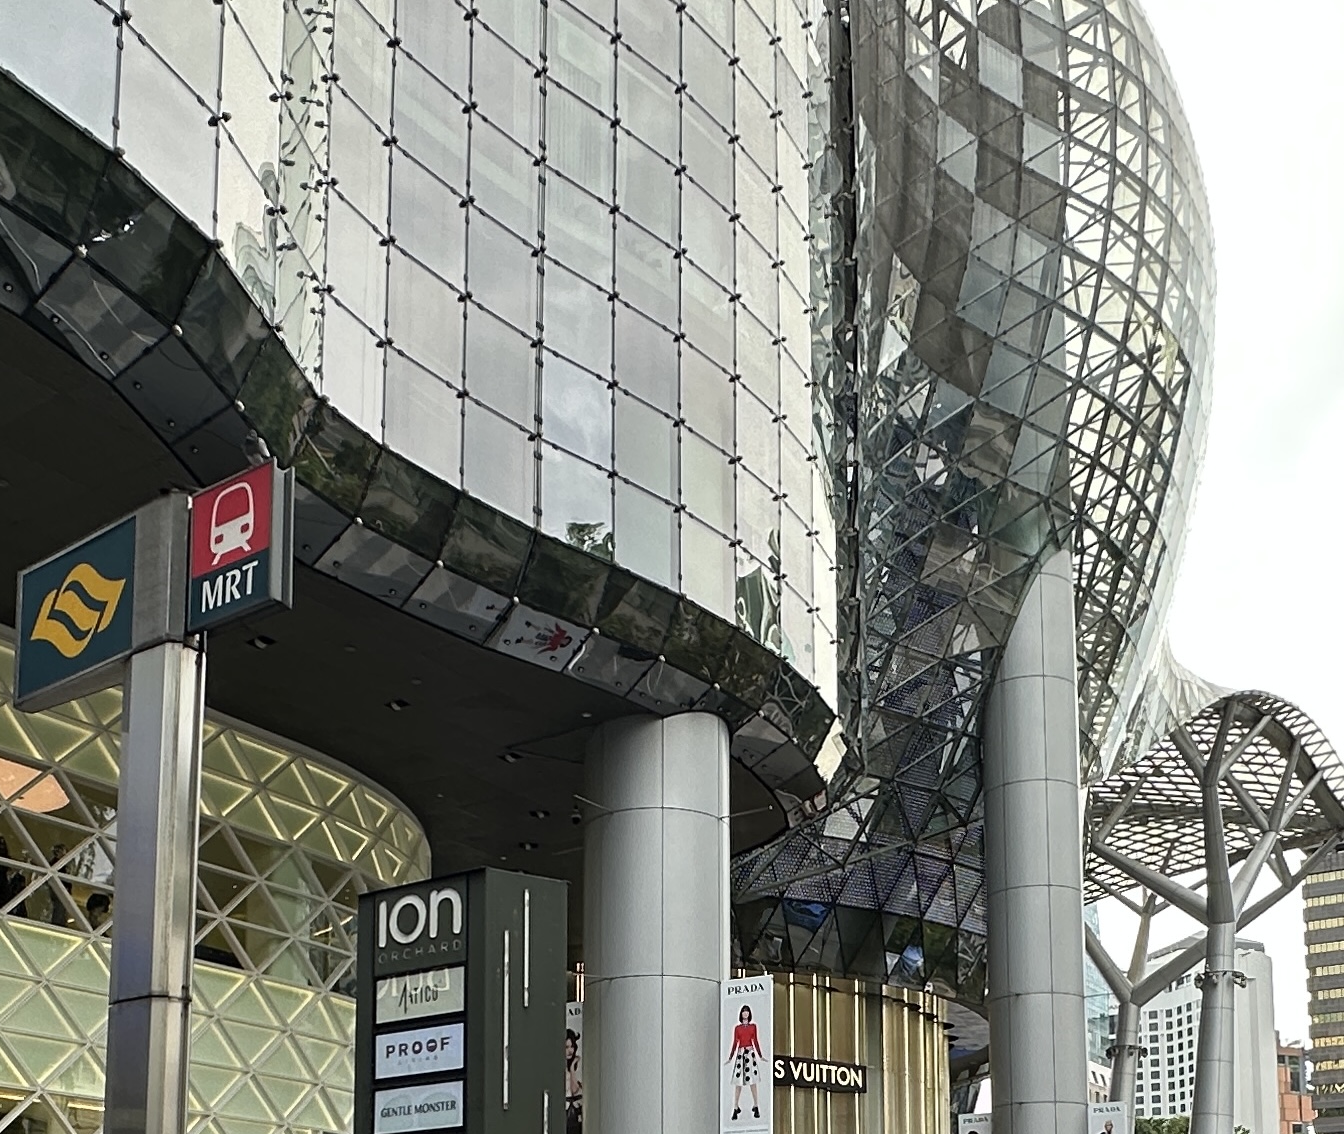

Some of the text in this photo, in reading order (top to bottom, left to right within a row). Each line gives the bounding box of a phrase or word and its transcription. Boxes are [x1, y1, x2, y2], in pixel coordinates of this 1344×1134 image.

[201, 560, 259, 613] MRT
[378, 940, 461, 964] ORCHARD
[727, 982, 765, 995] PRADA
[386, 1036, 452, 1059] PROOF
[789, 1060, 863, 1088] VUITTON
[381, 1100, 456, 1118] GENTLE MONSTER
[1093, 1106, 1121, 1114] PRADA
